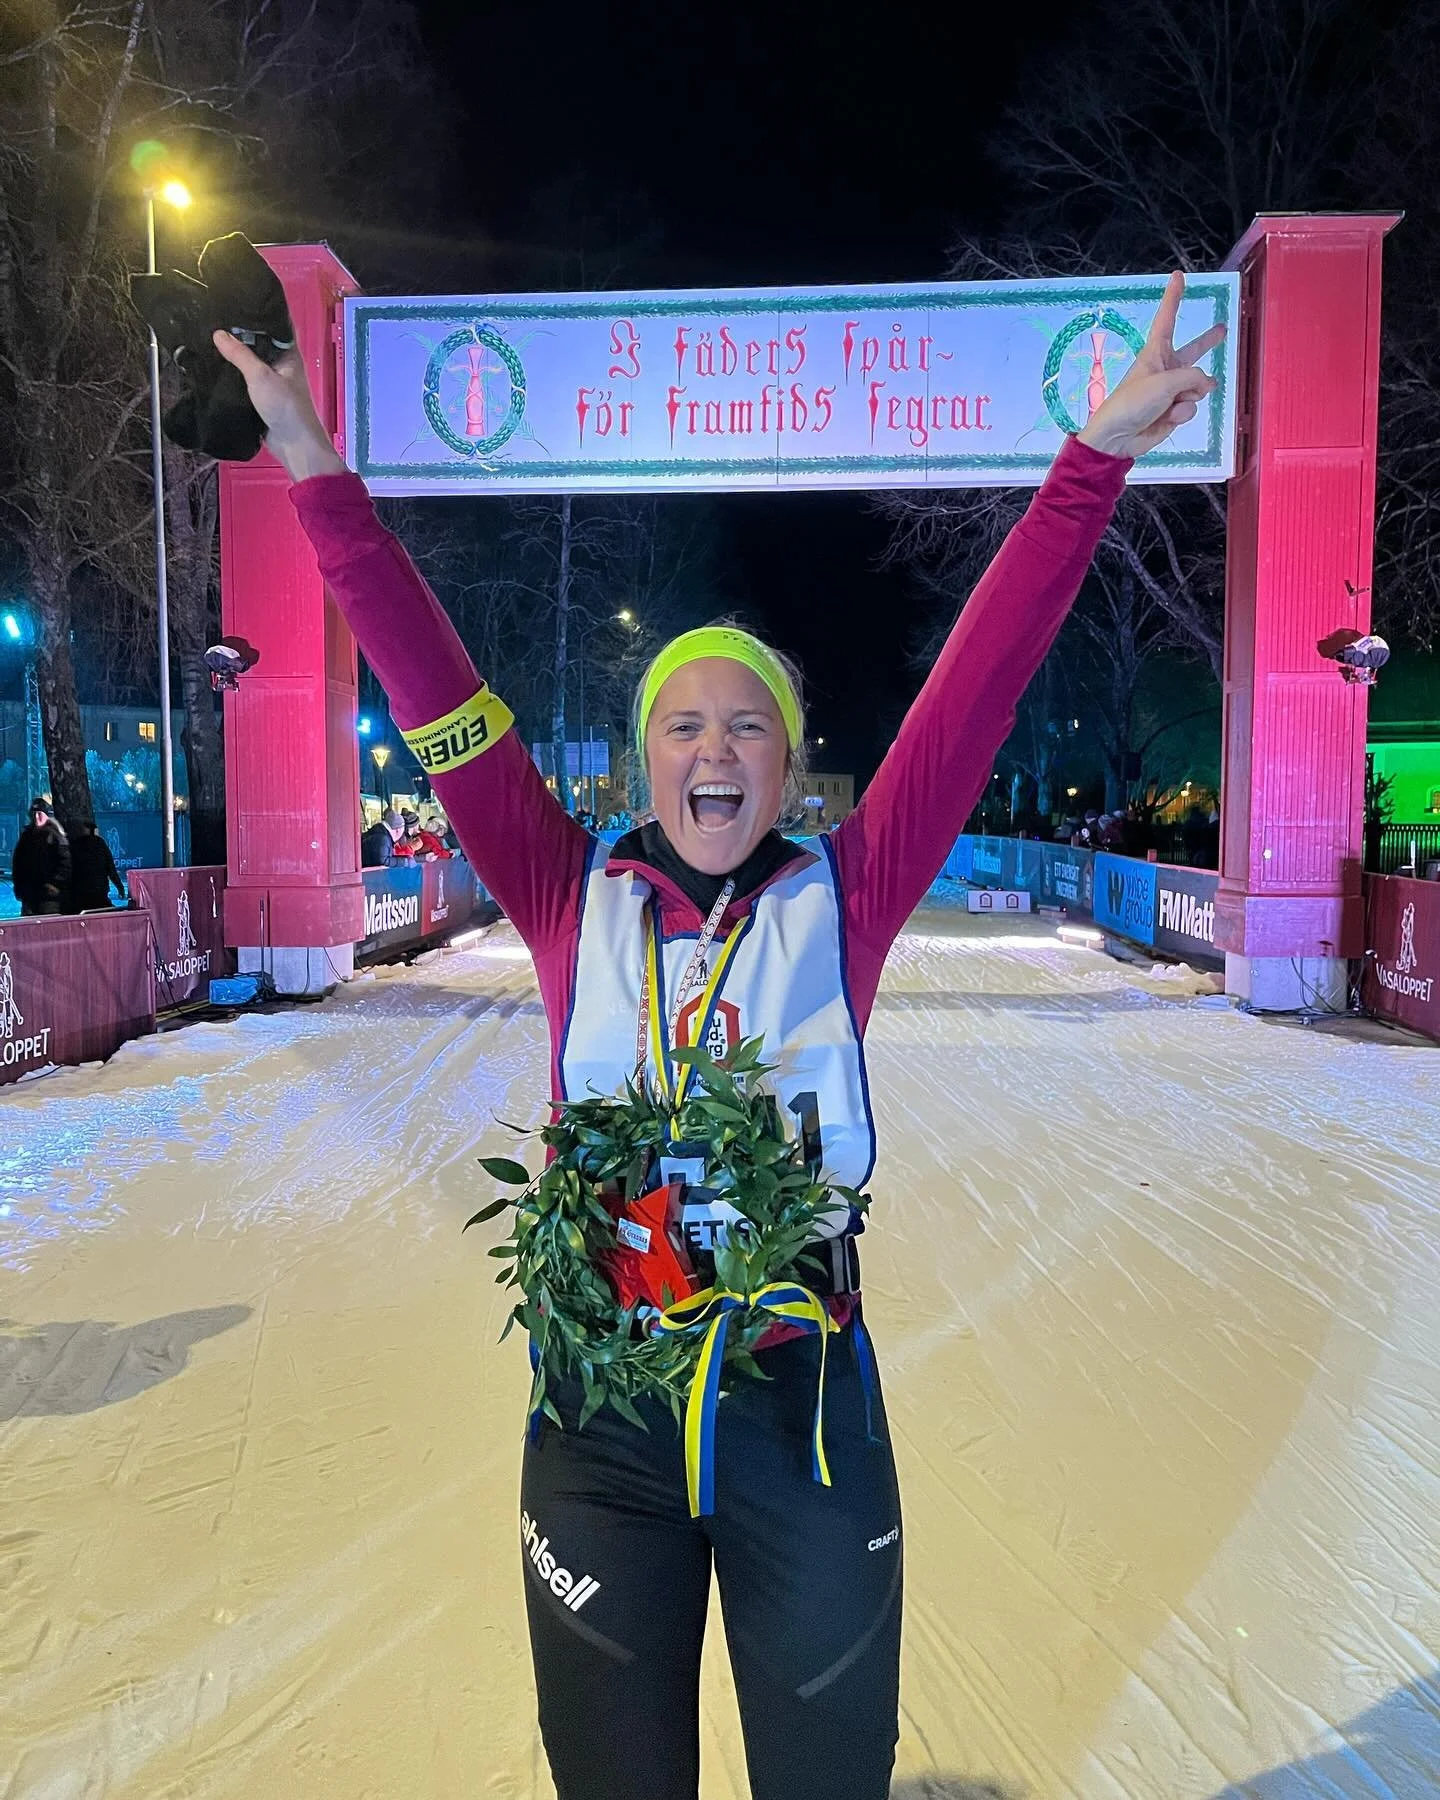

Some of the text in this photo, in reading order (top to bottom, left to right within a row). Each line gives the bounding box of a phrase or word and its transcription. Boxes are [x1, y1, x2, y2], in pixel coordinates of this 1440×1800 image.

[364, 893, 418, 936] Mattsson
[1376, 962, 1434, 1002] VASALOPPET
[868, 1529, 897, 1551] CRAFT
[521, 1510, 601, 1612] ahlsell
